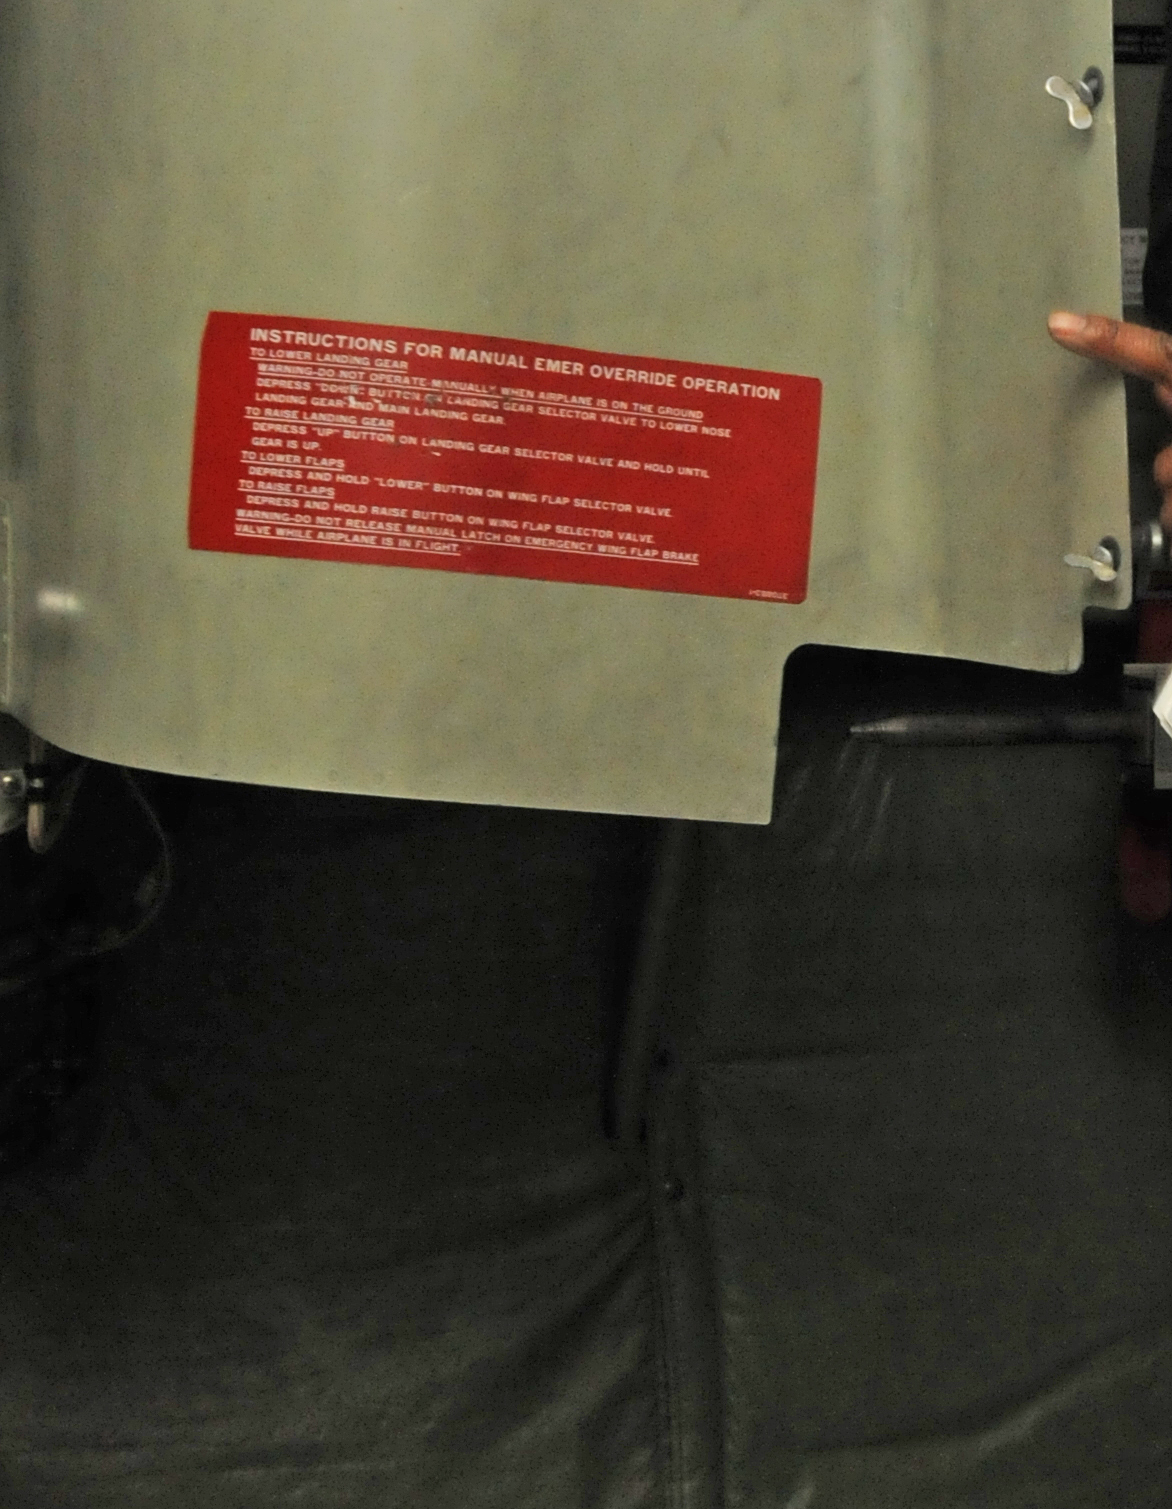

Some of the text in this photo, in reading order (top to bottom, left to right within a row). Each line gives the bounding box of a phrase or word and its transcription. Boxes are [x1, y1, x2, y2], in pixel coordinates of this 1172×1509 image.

[250, 346, 408, 370] TO LOWER LANDING GEAR
[250, 327, 780, 401] INSTRUCTIONS FOR MANUAL EMER OVERRIDE OPERATION
[254, 390, 307, 406] LANDING
[310, 396, 344, 408] GEAR
[378, 403, 410, 415] MAIN
[414, 406, 468, 421] LANDING
[256, 376, 311, 392] DEPRESS
[368, 387, 420, 401] BUTTON
[446, 395, 499, 409] LANDING
[502, 402, 533, 414] GEAR
[538, 406, 596, 421] SELECTOR
[600, 413, 637, 426] VALVE
[641, 418, 656, 429] TO
[659, 421, 697, 433] LOWER
[701, 426, 731, 438] NOSE
[257, 361, 335, 378] WARNING-DO
[339, 369, 365, 380] NOT
[370, 372, 426, 387] OPERATE
[500, 386, 534, 399] WHEN
[538, 391, 592, 406] AIRPLANE
[596, 398, 607, 408] IS
[611, 400, 628, 410] ON
[632, 402, 654, 413] THE
[657, 405, 704, 419] GROUND
[245, 405, 394, 428] TO RAISE LANDING GEAR
[241, 450, 345, 468] TO LOWER FLAPS
[251, 436, 283, 448] GEAR
[286, 439, 298, 449] IS
[252, 420, 307, 436] DEPRESS
[343, 429, 395, 443] BUTTON
[398, 434, 417, 445] ON
[421, 437, 475, 452] LANDING
[478, 443, 510, 455] GEAR
[514, 447, 574, 462] SELECTOR
[577, 454, 613, 467] VALVE
[617, 459, 641, 470] AND
[643, 462, 674, 474] HOLD
[677, 466, 710, 479] UNTIL
[238, 478, 335, 497] TO RAISE FLAPS
[248, 465, 302, 480] DEPRESS
[306, 471, 332, 482] AND
[335, 473, 369, 486] HOLD
[432, 483, 483, 497] BUTTON
[486, 488, 503, 499] ON
[507, 491, 537, 502] WING
[541, 494, 570, 506] FLAP
[573, 498, 632, 513] SELECTOR
[234, 522, 271, 535] VALVE
[275, 526, 312, 539] WHILE
[316, 530, 377, 545] AIRPLANE
[381, 536, 394, 547] IS
[398, 538, 411, 548] IN
[235, 507, 699, 562] WARNING-DO NOT RELEASE MANUAL LATCH ON EMERGENCY WING FLAP BRAKE
[246, 493, 299, 509] DEPRESS
[303, 499, 329, 511] AND
[333, 502, 367, 514] HOLD
[370, 505, 408, 518] RAISE
[412, 509, 463, 523] BUTTON
[467, 515, 484, 525] ON
[488, 517, 519, 529] WING
[522, 521, 551, 532] FLAP
[555, 524, 613, 539] SELECTOR
